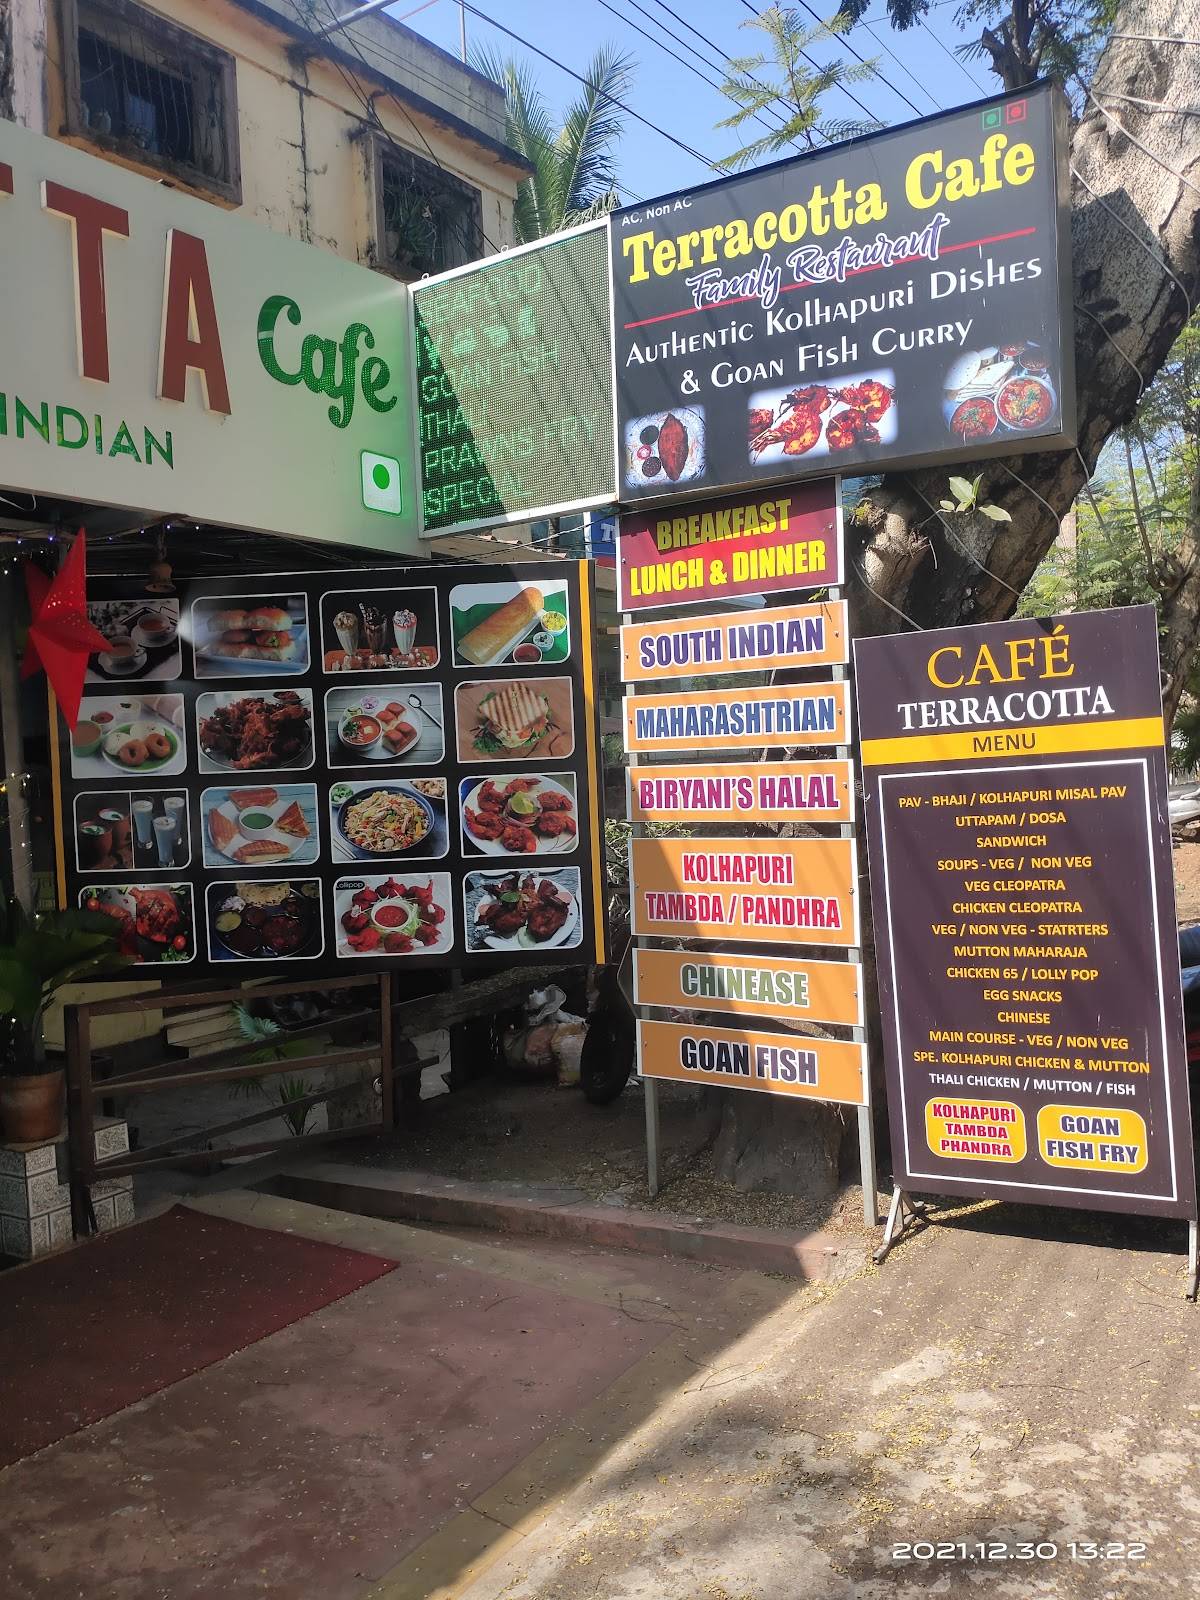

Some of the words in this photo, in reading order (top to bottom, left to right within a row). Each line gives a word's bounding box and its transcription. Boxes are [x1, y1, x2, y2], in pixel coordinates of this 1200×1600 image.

[621, 214, 643, 228] AC,
[646, 205, 670, 219] Non
[673, 196, 693, 212] AC
[622, 178, 888, 284] Terracotta
[905, 133, 1035, 209] Cafe
[685, 253, 781, 310] Family
[786, 212, 950, 282] Restaurant
[0, 162, 231, 416] TA
[257, 295, 398, 428] Cafe
[680, 368, 701, 395] &
[656, 499, 791, 551] BREAKFAST
[630, 557, 704, 597] LUNCH
[709, 559, 728, 586] &
[732, 540, 826, 582] DINNER
[640, 629, 721, 668] SOUTH
[728, 617, 824, 659] INDIAN
[927, 624, 1075, 688] CAFÉ
[636, 698, 835, 739] MAHARASHTRIAN
[898, 685, 1115, 730] TERRACOTTA
[973, 732, 1036, 753] MENU
[639, 777, 752, 810] BIRYANI'S
[760, 775, 839, 808] HALAL
[898, 796, 922, 808] PAV
[932, 793, 967, 807] BHAJI
[979, 790, 1052, 804] KOLHAPURI
[1055, 787, 1098, 801] MISAL
[1101, 786, 1127, 798] PAV
[955, 814, 1016, 827] UTTAPAM
[1029, 812, 1066, 825] DOSA
[976, 835, 1047, 848] SANDWICH
[683, 854, 793, 884] KOLHAPURI
[937, 858, 979, 871] SOUPS
[989, 858, 1015, 870] VEG
[1031, 857, 1061, 869] NON
[1065, 856, 1092, 868] VEG
[965, 880, 990, 892] VEG
[993, 879, 1066, 892] CLEOPATRA
[645, 892, 723, 923] TAMBDA
[728, 896, 737, 924] /
[743, 896, 841, 928] PANDHRA
[952, 902, 1006, 914] CHICKEN
[1008, 901, 1082, 913] CLEOPATRA
[931, 924, 956, 936] VEG
[969, 924, 998, 936] NON
[1001, 924, 1027, 936] VEG
[1038, 924, 1108, 936] STATRTERS
[954, 946, 1010, 957] MUTTON
[1013, 946, 1088, 958] MAHARAJA
[681, 964, 808, 1006] CHINEASE
[946, 967, 1000, 979] CHICKEN
[1003, 968, 1018, 980] 65
[1031, 968, 1067, 980] LOLLY
[1071, 969, 1099, 981] POP
[983, 990, 1009, 1001] EGG
[1012, 990, 1063, 1002] SNACKS
[997, 1011, 1050, 1024] CHINESE
[929, 1030, 963, 1042] MAIN
[966, 1032, 1016, 1045] COURSE
[1027, 1034, 1053, 1047] VEG
[1066, 1036, 1097, 1048] NON
[1101, 1037, 1129, 1050] VEG
[681, 1037, 750, 1076] GOAN
[757, 1046, 817, 1085] FISH
[913, 1051, 939, 1063] SPE.
[941, 1052, 1012, 1066] KOLHAPURI
[1015, 1056, 1071, 1069] CHICKEN
[1074, 1058, 1085, 1070] &
[1088, 1060, 1150, 1074] MUTTON
[928, 1072, 963, 1085] THALI
[966, 1075, 1020, 1089] CHICKEN
[1033, 1078, 1092, 1093] MUTTON
[1106, 1082, 1136, 1095] FISH
[933, 1103, 1016, 1122] KOLHAPURI
[945, 1123, 1008, 1139] TAMBDA
[1061, 1115, 1120, 1136] GOAN
[941, 1139, 1012, 1157] PHANDRA
[1046, 1139, 1094, 1160] FISH
[1100, 1143, 1138, 1164] FRY
